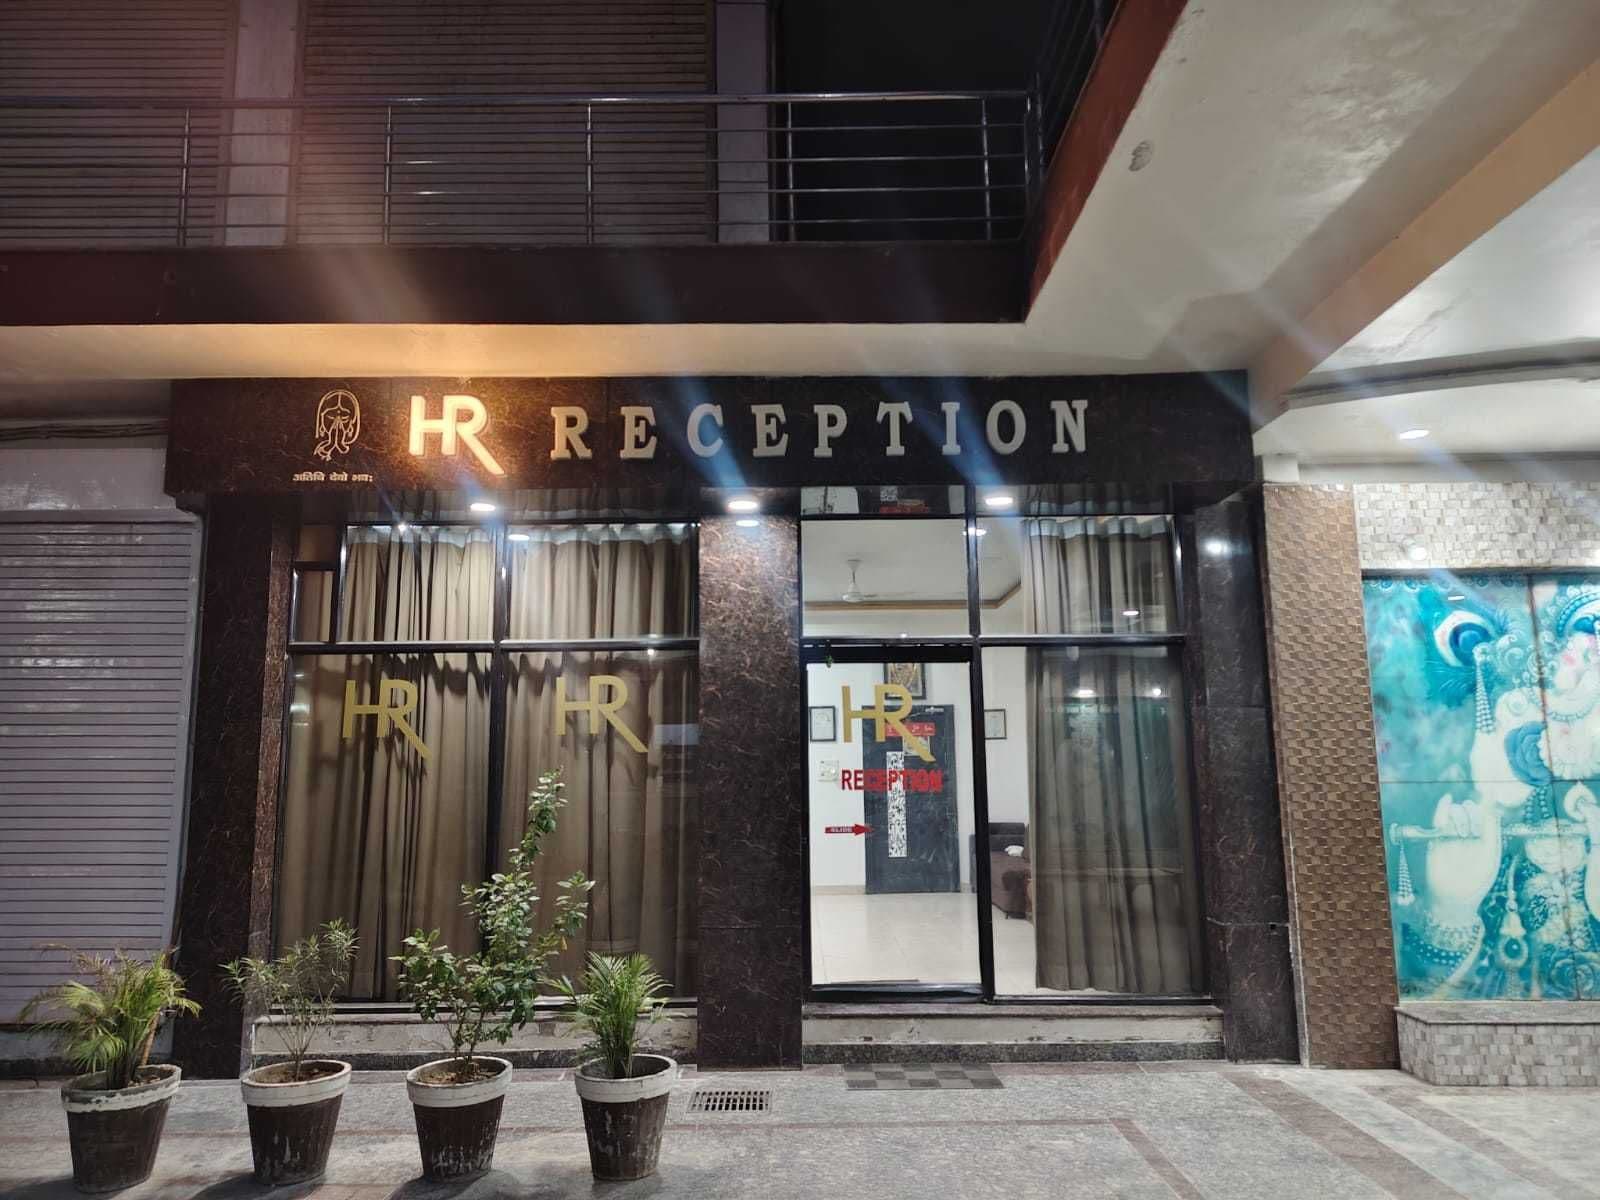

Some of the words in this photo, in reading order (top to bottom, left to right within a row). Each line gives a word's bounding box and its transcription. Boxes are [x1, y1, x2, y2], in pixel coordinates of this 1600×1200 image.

[408, 395, 504, 476] HR
[550, 400, 1088, 460] RECEPTION
[342, 679, 431, 758] HR
[555, 675, 649, 753] HR
[842, 684, 936, 762] HR
[841, 768, 943, 792] RECEPTION
